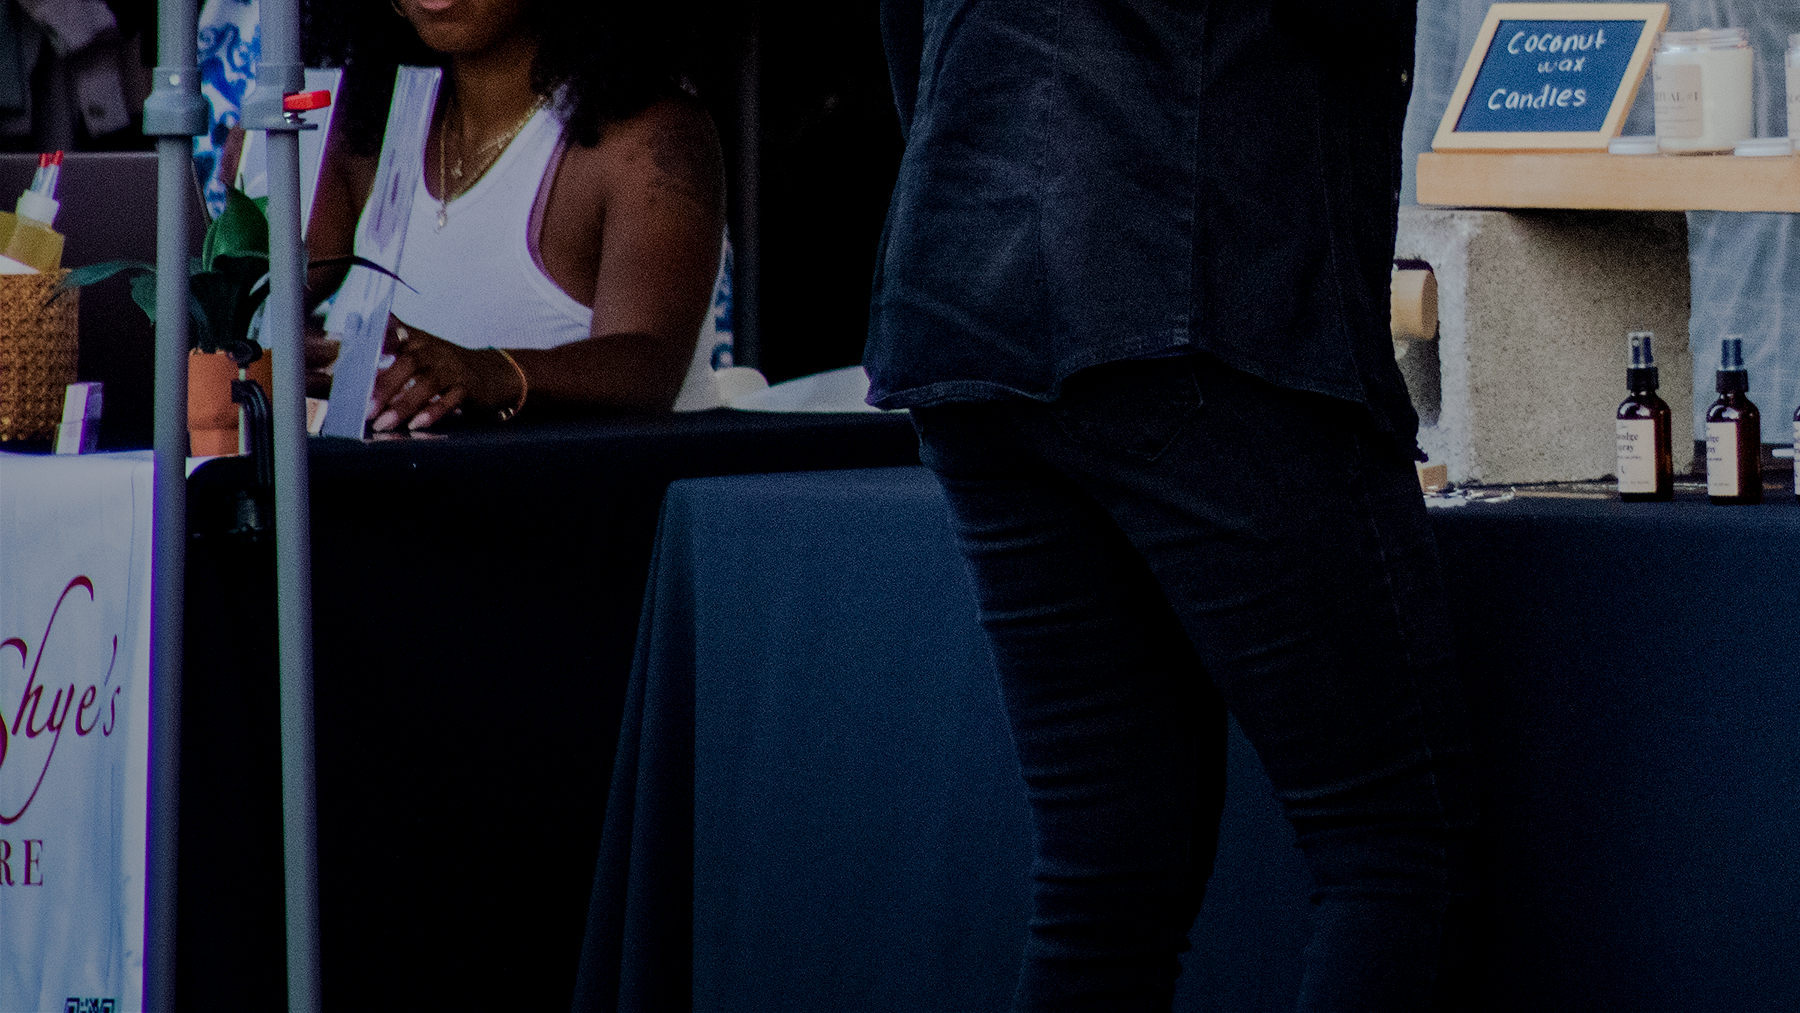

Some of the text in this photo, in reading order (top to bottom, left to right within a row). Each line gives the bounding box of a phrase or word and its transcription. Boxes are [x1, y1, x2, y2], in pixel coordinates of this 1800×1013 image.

[1507, 29, 1606, 55] Coconut
[1537, 57, 1586, 74] wax
[1488, 83, 1586, 110] Candles
